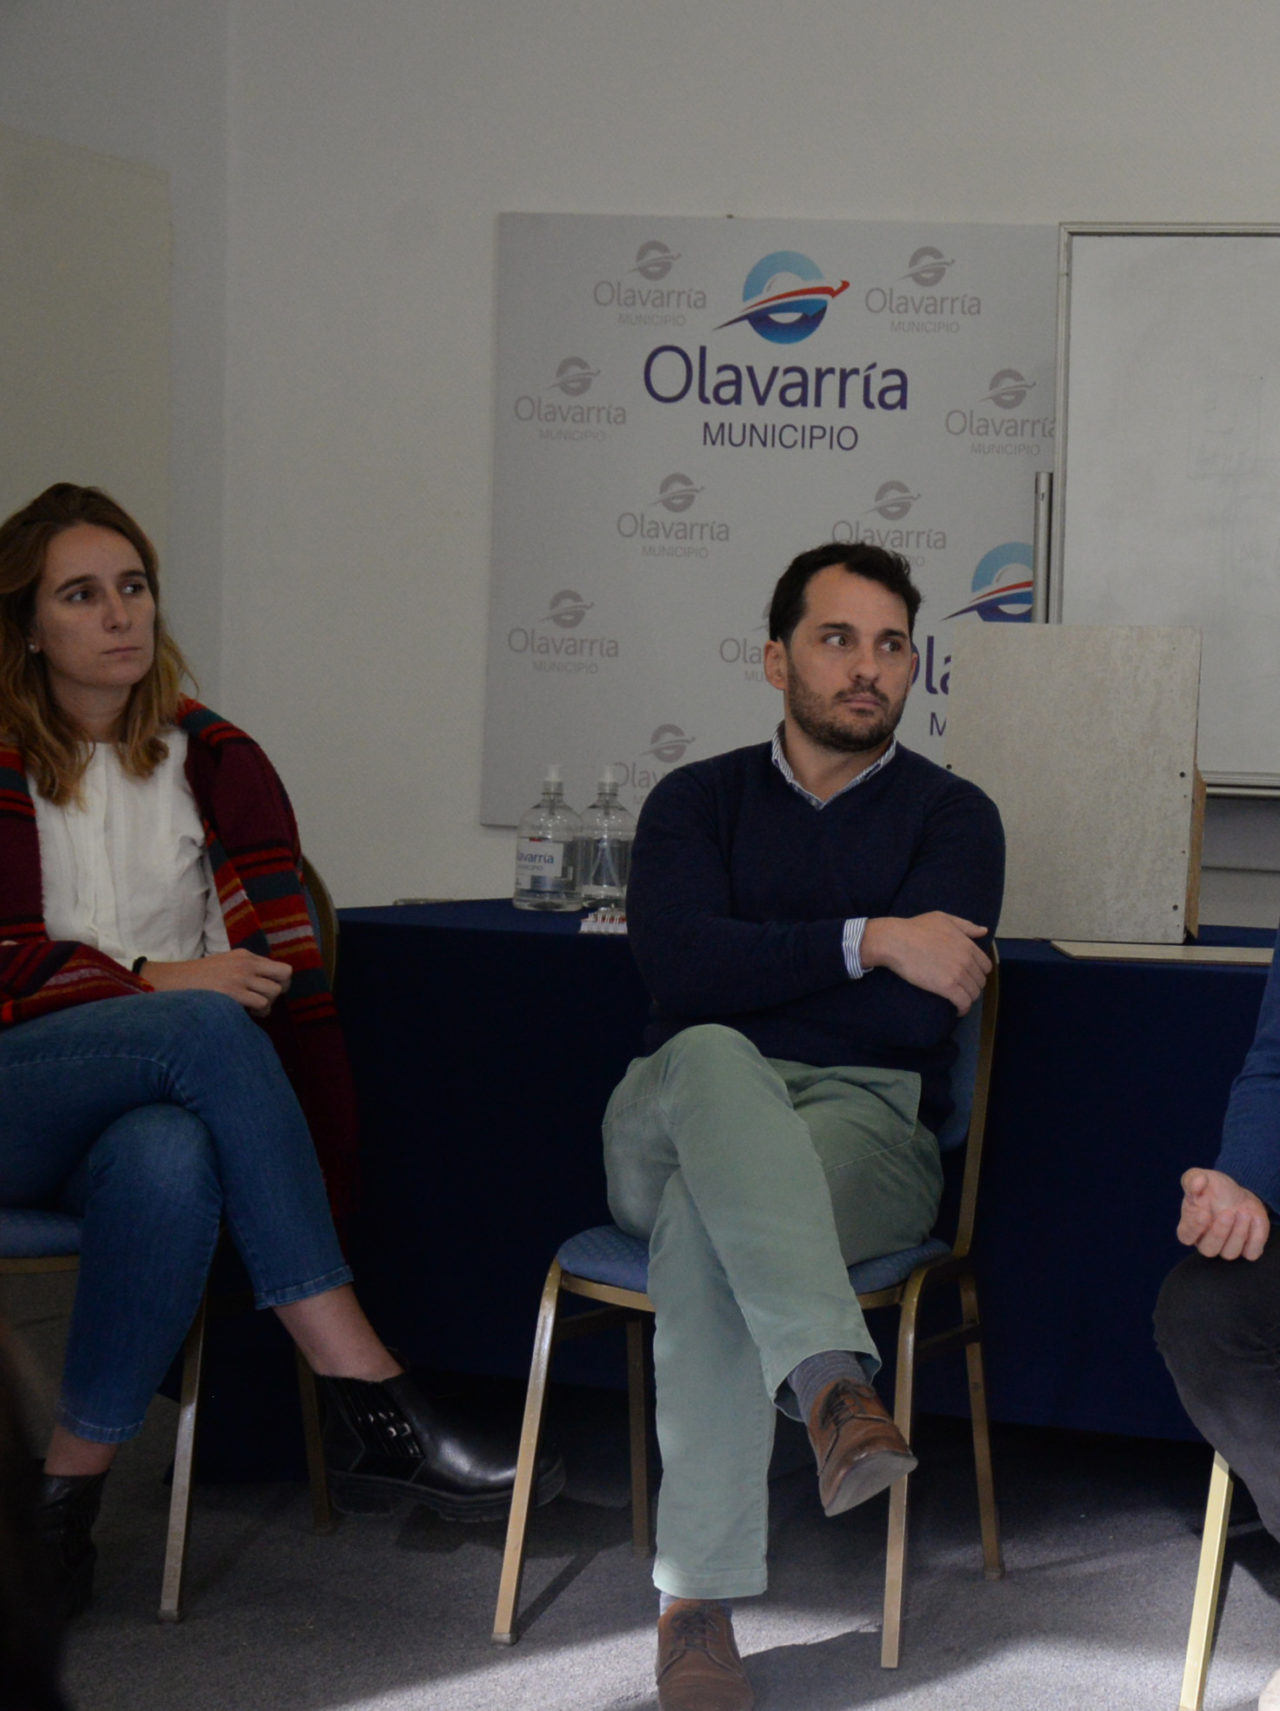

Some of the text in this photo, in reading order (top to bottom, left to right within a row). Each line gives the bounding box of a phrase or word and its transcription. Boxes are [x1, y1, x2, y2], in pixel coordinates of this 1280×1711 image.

[593, 281, 708, 310] Olavarría
[865, 288, 982, 316] Olavarría
[617, 312, 687, 327] MUNICIPIO
[890, 320, 961, 334] MUNICIPIO
[643, 345, 909, 411] Olavarría
[513, 395, 627, 426] Olavarría
[702, 421, 859, 452] MUNICIPIO
[970, 443, 1041, 458] MUNICIPIO
[617, 512, 730, 543] Olavarría
[641, 545, 709, 560] MUNICIPIO
[507, 627, 620, 658] Olavarría
[532, 660, 599, 675] MUNICIPIO
